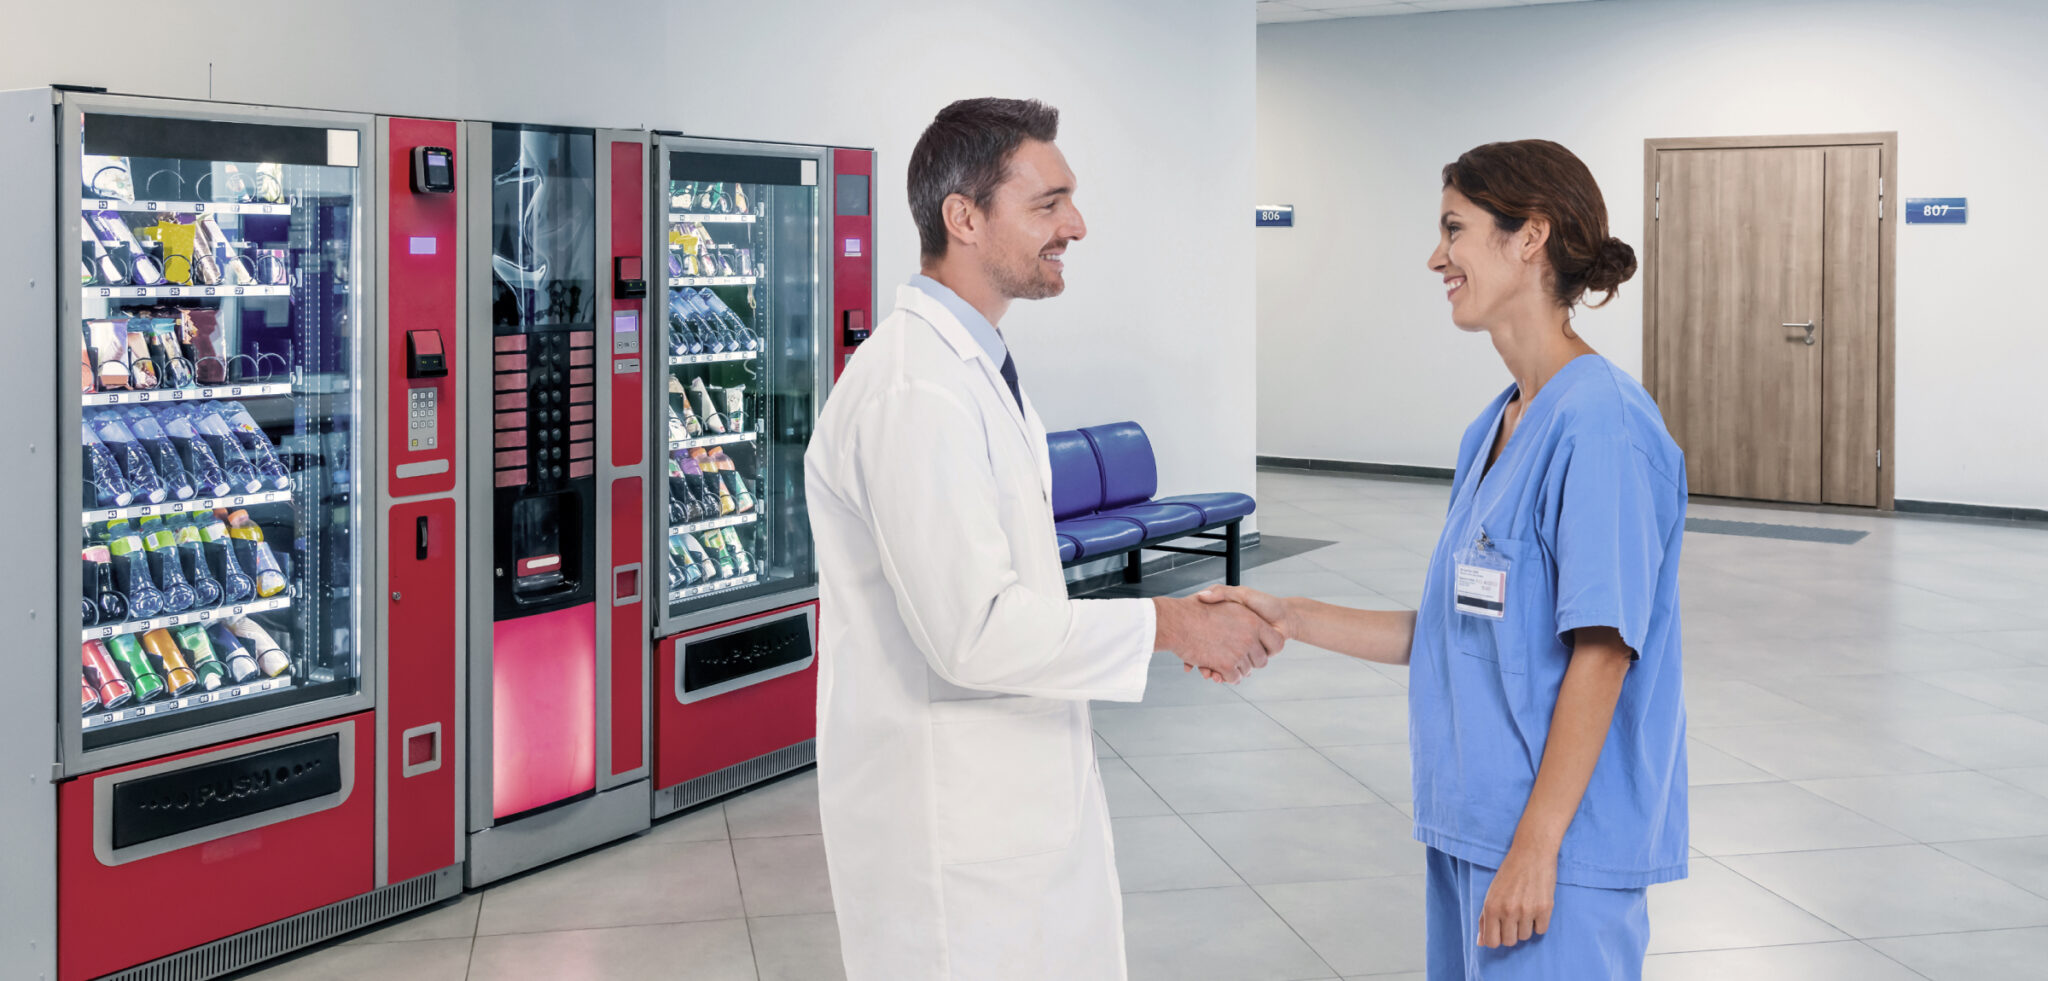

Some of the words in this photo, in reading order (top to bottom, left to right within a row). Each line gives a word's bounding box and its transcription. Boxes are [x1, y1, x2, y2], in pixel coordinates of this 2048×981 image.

[1923, 205, 1949, 216] 807
[1262, 211, 1280, 221] 806
[138, 288, 146, 296] 24
[141, 393, 149, 401] 34
[174, 391, 182, 399] 35
[197, 769, 272, 808] PUSH
